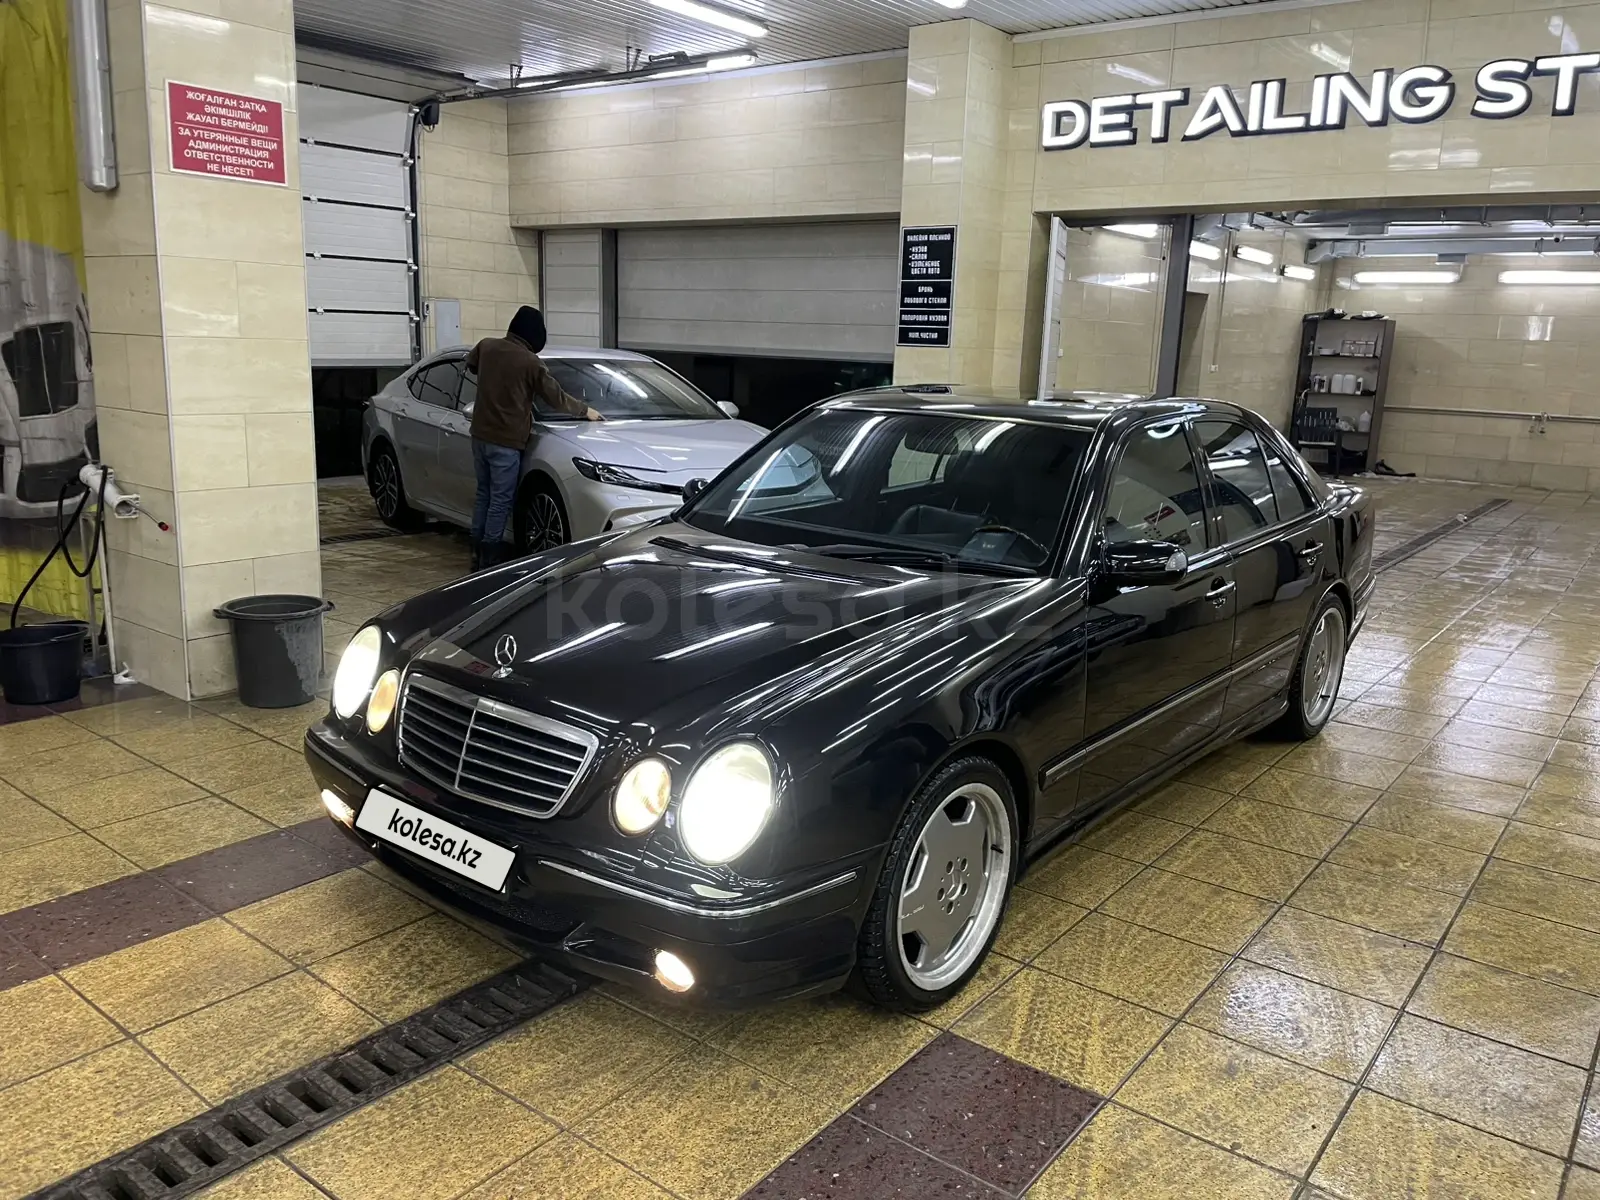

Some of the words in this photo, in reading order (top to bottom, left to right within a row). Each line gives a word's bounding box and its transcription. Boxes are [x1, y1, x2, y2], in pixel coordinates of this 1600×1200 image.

[186, 90, 236, 106] ЖОҒАЛҒАН
[240, 100, 266, 113] ЗАТҚА
[1042, 65, 1455, 151] DETAILING
[1471, 51, 1600, 119] ST
[186, 112, 219, 125] ЖАУАП
[204, 105, 251, 120] ӘКІМШІЛІК
[178, 127, 191, 136] ЗА
[192, 129, 248, 146] УТЕРЯННЫЕ
[251, 139, 278, 150] ВЕЩИ
[188, 140, 268, 158] АДМИНИСТРАЦИЯ
[184, 150, 274, 169] ОТВЕТСТВЕННОСТИ
[207, 164, 219, 172] НЕ
